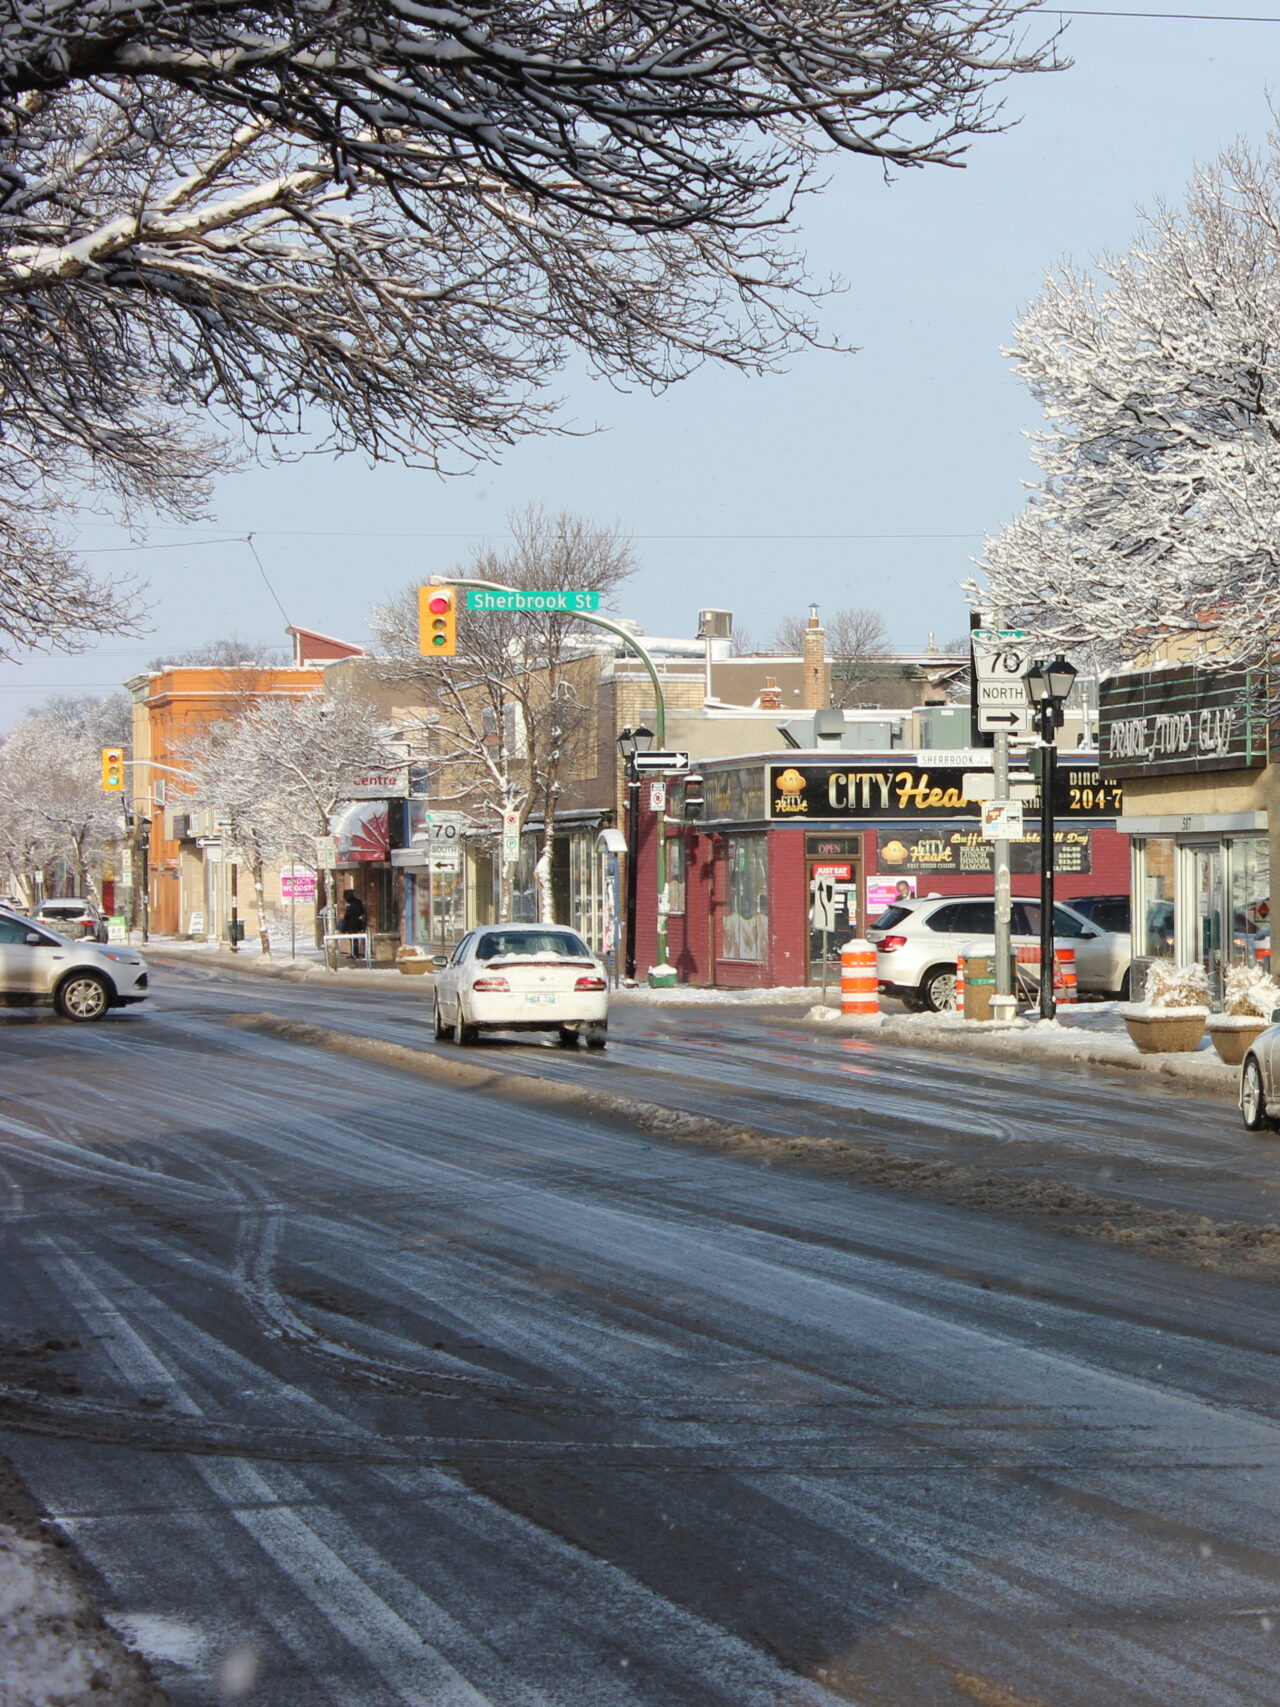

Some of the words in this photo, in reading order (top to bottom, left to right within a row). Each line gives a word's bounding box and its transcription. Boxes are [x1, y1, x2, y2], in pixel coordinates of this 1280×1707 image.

[474, 593, 567, 608] Sherbrook
[575, 594, 592, 608] St
[991, 651, 1020, 673] 70
[983, 687, 1023, 699] NORTH
[922, 756, 974, 765] SHERBROOK
[353, 775, 397, 786] Centre
[828, 772, 893, 809] CITY
[894, 771, 985, 809] Hea
[432, 825, 456, 839] 70
[1066, 832, 1089, 846] Day
[431, 845, 457, 853] SOUTH
[819, 844, 841, 853] OPEN
[910, 846, 952, 862] Heart
[918, 840, 944, 854] CITY
